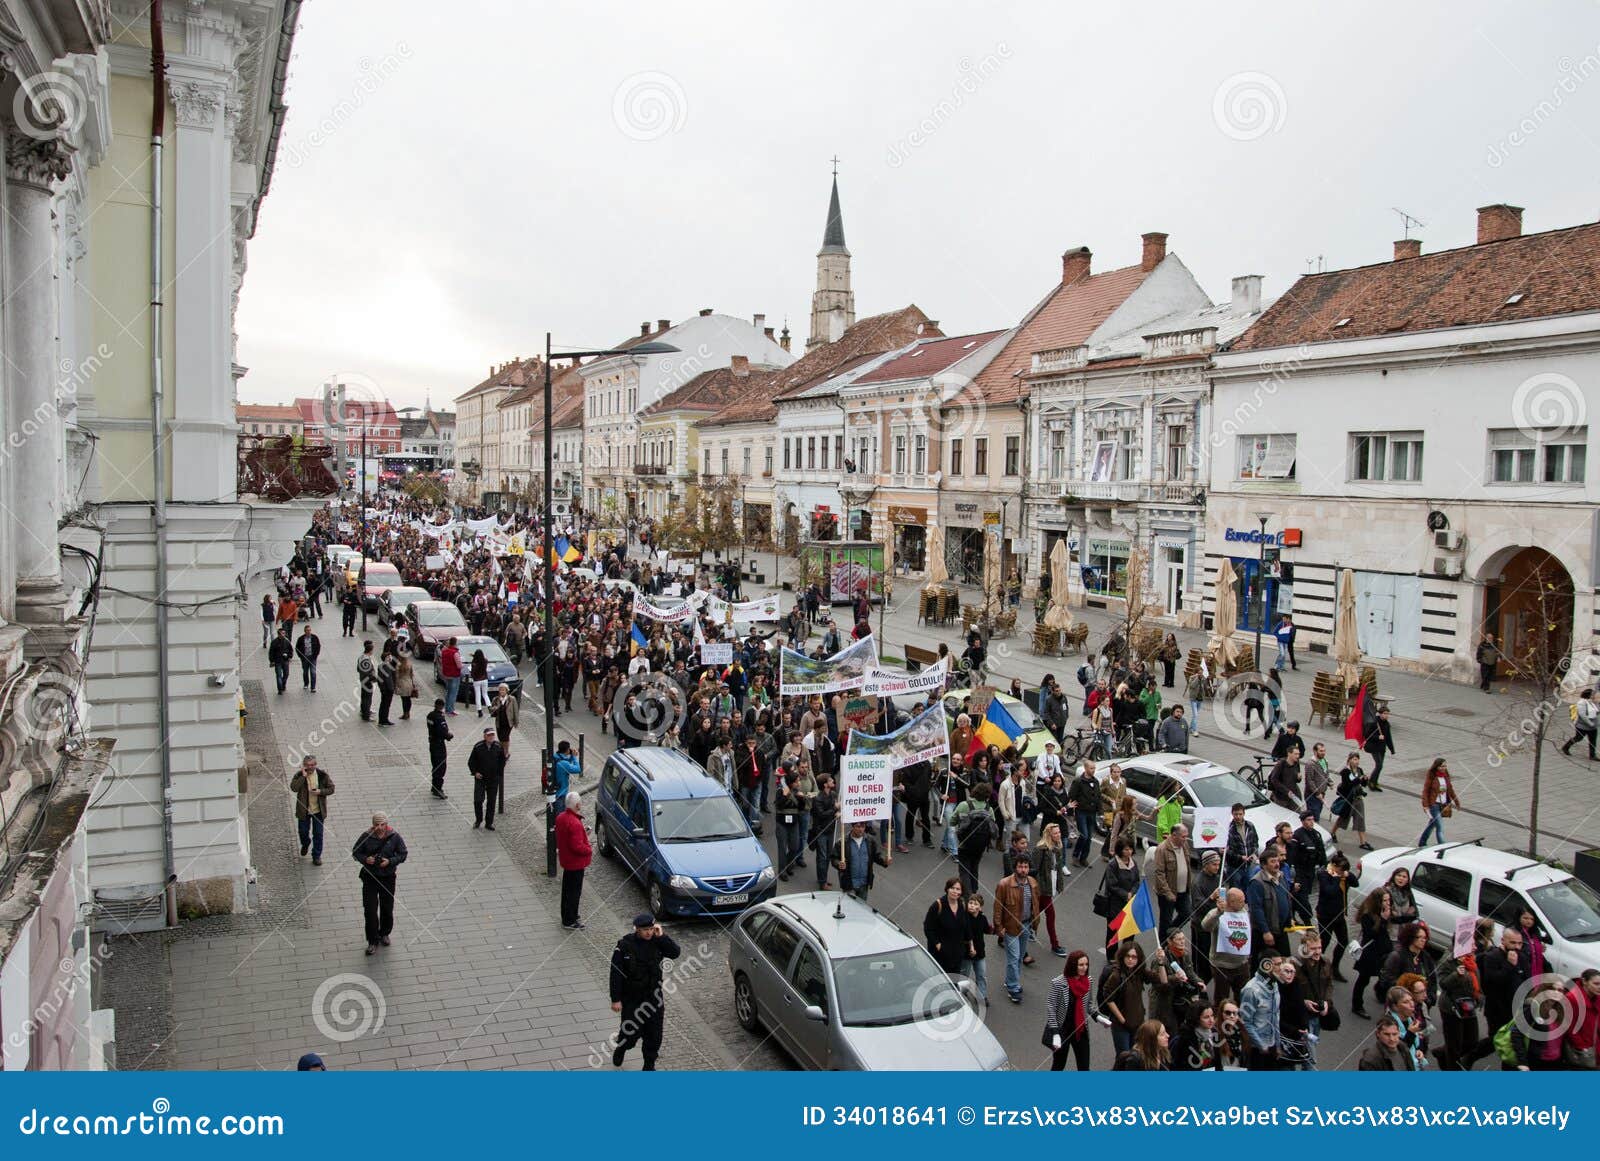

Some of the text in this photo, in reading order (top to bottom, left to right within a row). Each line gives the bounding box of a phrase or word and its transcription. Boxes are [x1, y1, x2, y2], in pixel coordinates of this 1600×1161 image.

[881, 680, 906, 692] sclavul
[857, 773, 875, 781] deci
[848, 784, 884, 794] NU CRED
[845, 796, 886, 806] reclamele
[853, 807, 877, 817] RMGC
